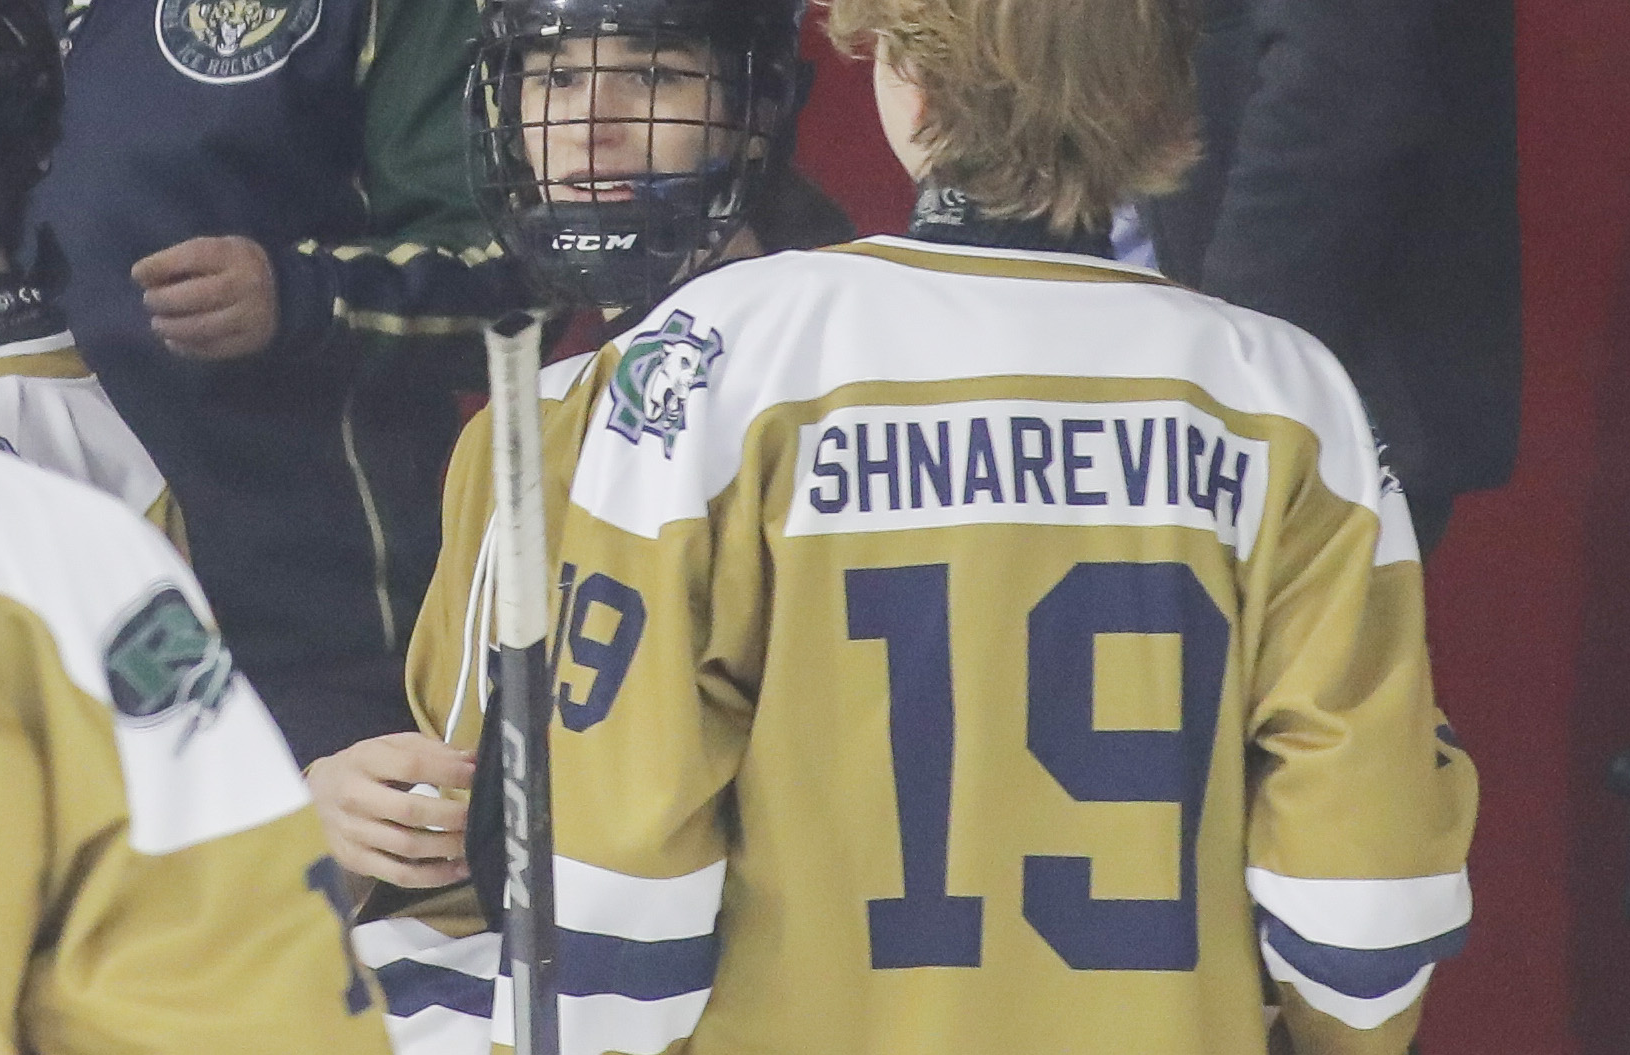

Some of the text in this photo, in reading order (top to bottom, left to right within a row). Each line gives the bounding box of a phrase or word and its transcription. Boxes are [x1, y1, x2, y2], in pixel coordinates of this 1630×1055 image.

[551, 233, 638, 251] CCM
[809, 417, 1250, 528] SHNAREVICH
[845, 560, 1231, 972] 19
